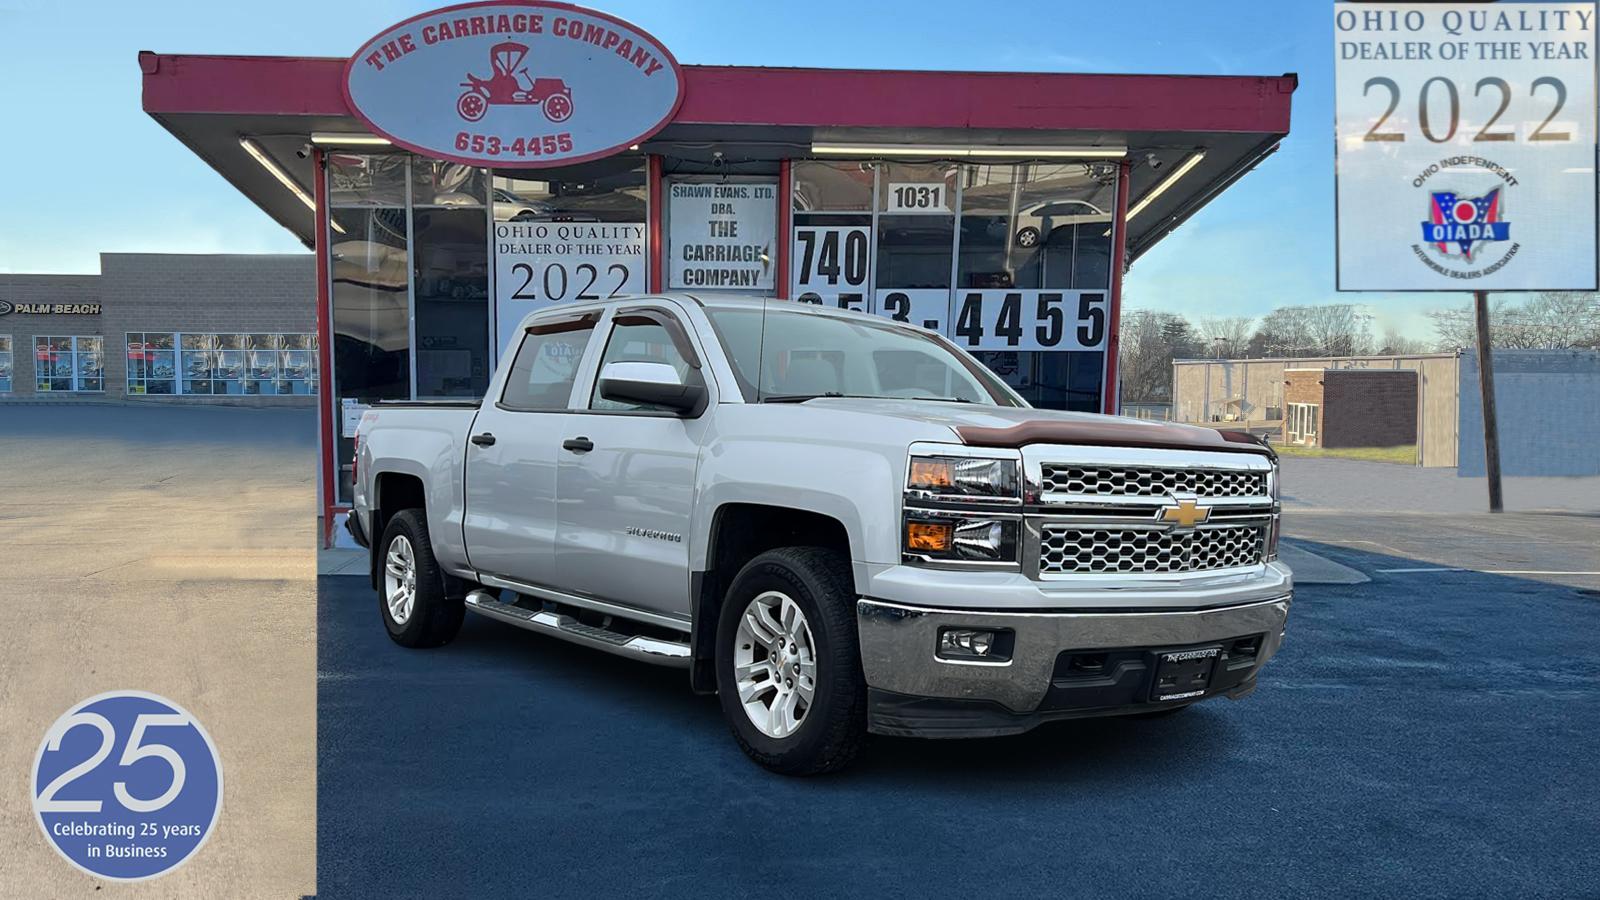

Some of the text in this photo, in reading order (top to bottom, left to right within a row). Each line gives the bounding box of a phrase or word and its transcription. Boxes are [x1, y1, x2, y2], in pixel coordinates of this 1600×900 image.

[1336, 10, 1592, 35] OHIO QUALITY
[366, 14, 663, 77] THE CARRIAGE COMPANY
[1340, 42, 1589, 60] DEALER OF THE YEAR
[1362, 76, 1570, 144] 2022
[455, 132, 573, 156] 653-4455
[1412, 156, 1519, 188] OHIO INDEPENDENT
[672, 186, 712, 199] SHAWN
[754, 186, 775, 199] LTD.
[895, 187, 940, 208] 1031
[711, 203, 736, 215] DBA.
[497, 226, 644, 241] OHIO QUALITY
[708, 221, 738, 237] THE
[1432, 224, 1495, 240] OIADA
[499, 244, 641, 255] DEALER OF THE YEAR
[683, 244, 762, 262] CARRIAGE
[797, 230, 867, 286] 740
[511, 263, 632, 300] 2022
[683, 268, 760, 286] COMPANY
[14, 304, 100, 314] PALM BEACH
[797, 292, 1104, 347] 3-4455
